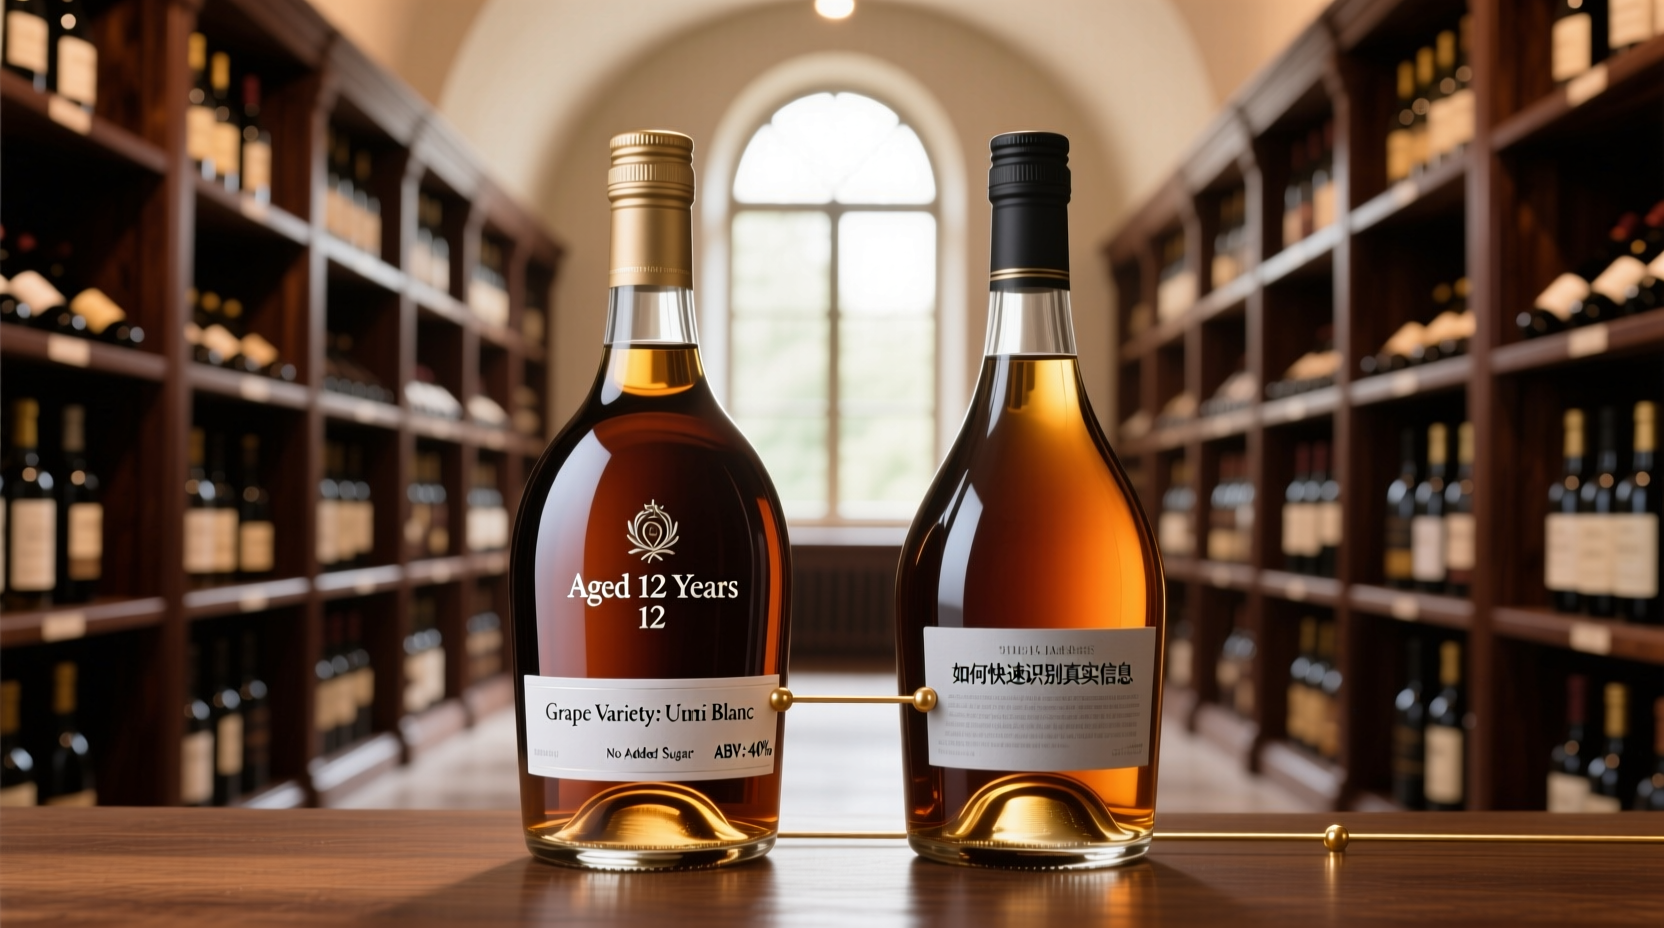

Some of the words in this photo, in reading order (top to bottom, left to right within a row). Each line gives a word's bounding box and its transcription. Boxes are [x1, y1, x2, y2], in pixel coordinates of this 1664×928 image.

[567, 572, 631, 607] Aged
[638, 574, 667, 599] 12
[671, 573, 739, 599] Years
[638, 605, 666, 629] 12
[952, 661, 1134, 686] 如何快速识别真实信息
[545, 702, 592, 727] Grape
[595, 703, 661, 728] Variety:
[711, 702, 755, 722] Blanc
[606, 747, 622, 759] No
[662, 746, 695, 762] Sugar
